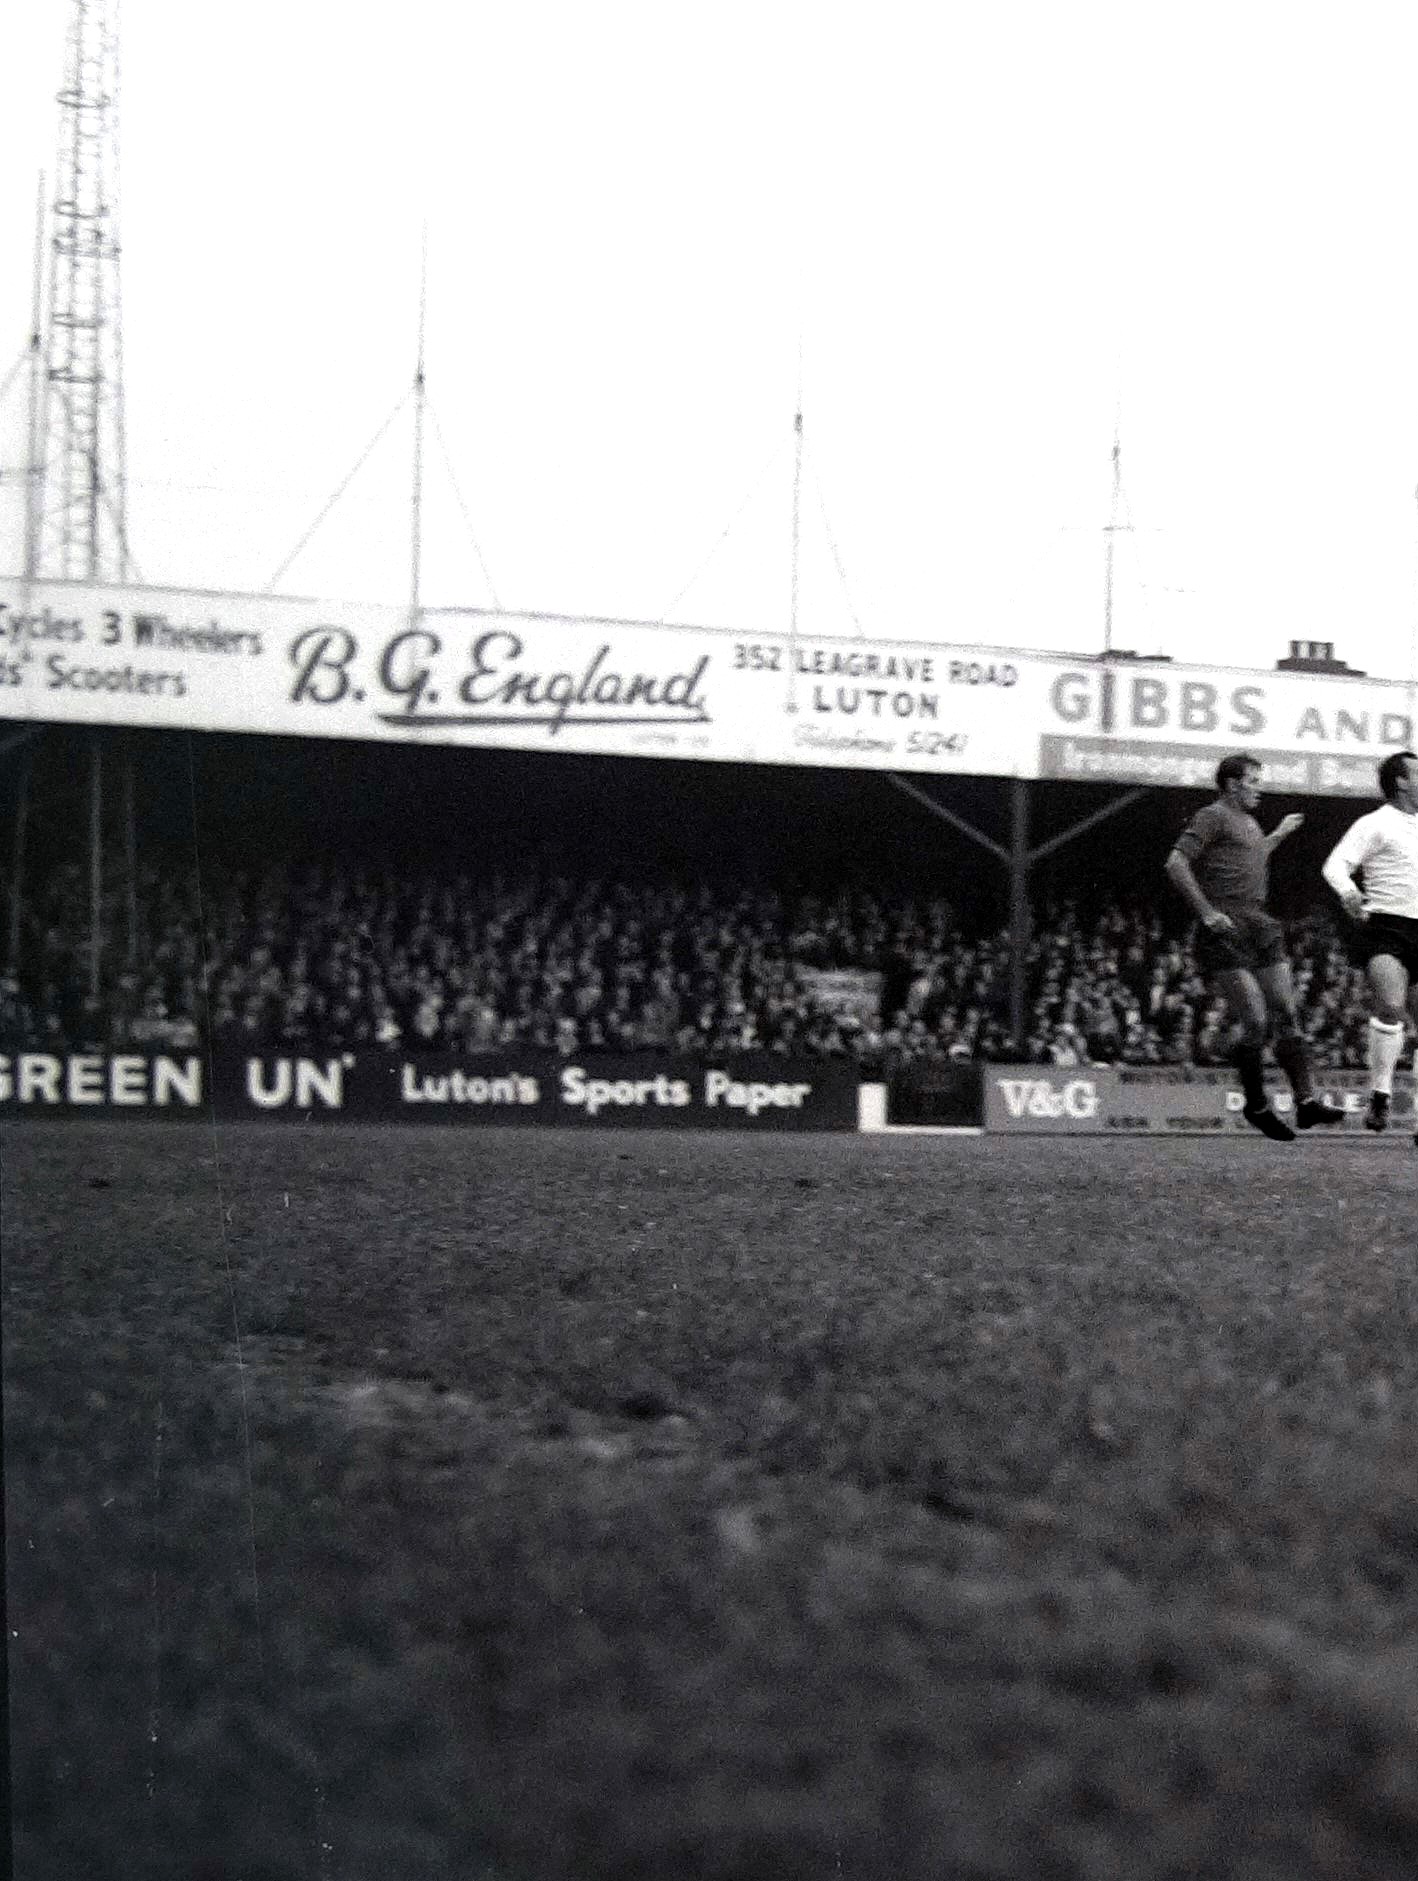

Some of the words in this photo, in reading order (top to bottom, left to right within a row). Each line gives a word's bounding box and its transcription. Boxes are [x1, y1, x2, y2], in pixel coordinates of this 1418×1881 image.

[0, 603, 85, 645] ycles
[102, 608, 122, 647] 3
[132, 611, 265, 657] Wheelers
[47, 652, 188, 698] Scooters
[457, 630, 711, 736] England
[733, 644, 782, 672] 352
[798, 650, 936, 683] LEAGRAVE
[948, 660, 1020, 688] ROAD
[813, 685, 938, 720] LUTON
[1049, 671, 1266, 737] GIBBS
[1295, 705, 1416, 748] AND
[0, 1052, 201, 1106] REEN
[401, 1062, 539, 1105] Luton's
[561, 1066, 692, 1114] Sports
[705, 1069, 812, 1115] Paper
[998, 1079, 1099, 1118] V&G
